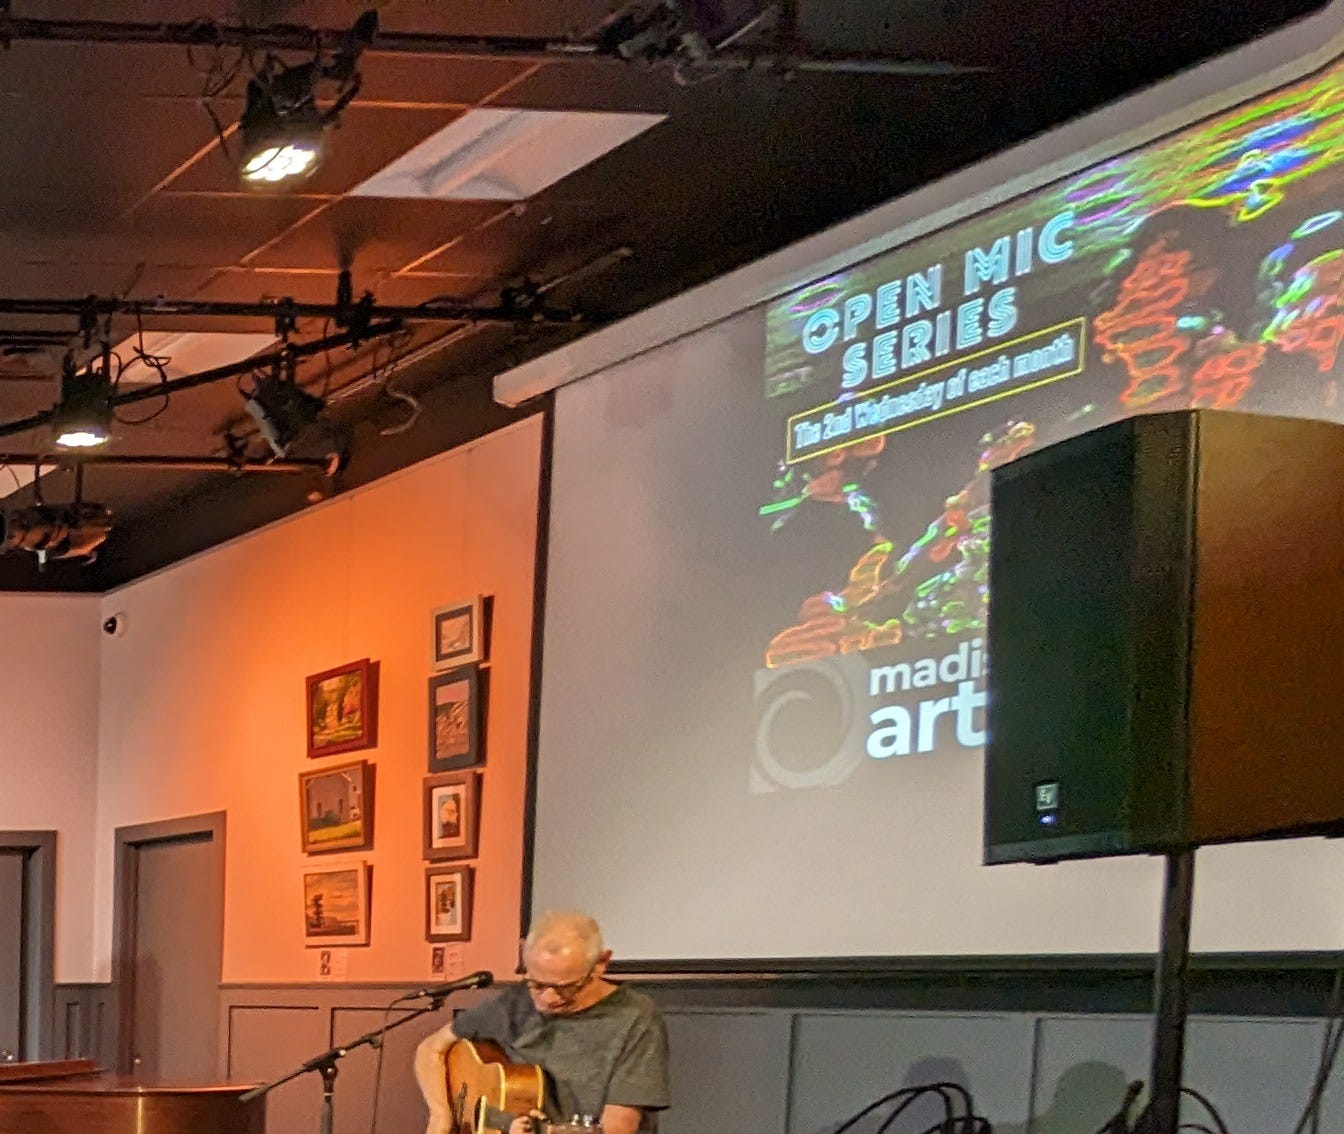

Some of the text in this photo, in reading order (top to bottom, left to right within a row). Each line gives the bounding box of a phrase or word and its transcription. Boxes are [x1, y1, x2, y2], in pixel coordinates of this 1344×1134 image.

[802, 211, 1075, 354] OPEN MIC
[841, 287, 1018, 388] SERIES
[794, 419, 821, 449] The
[823, 407, 851, 440] 2nd
[946, 369, 968, 400] of
[968, 355, 1011, 393] each
[1012, 333, 1075, 378] month
